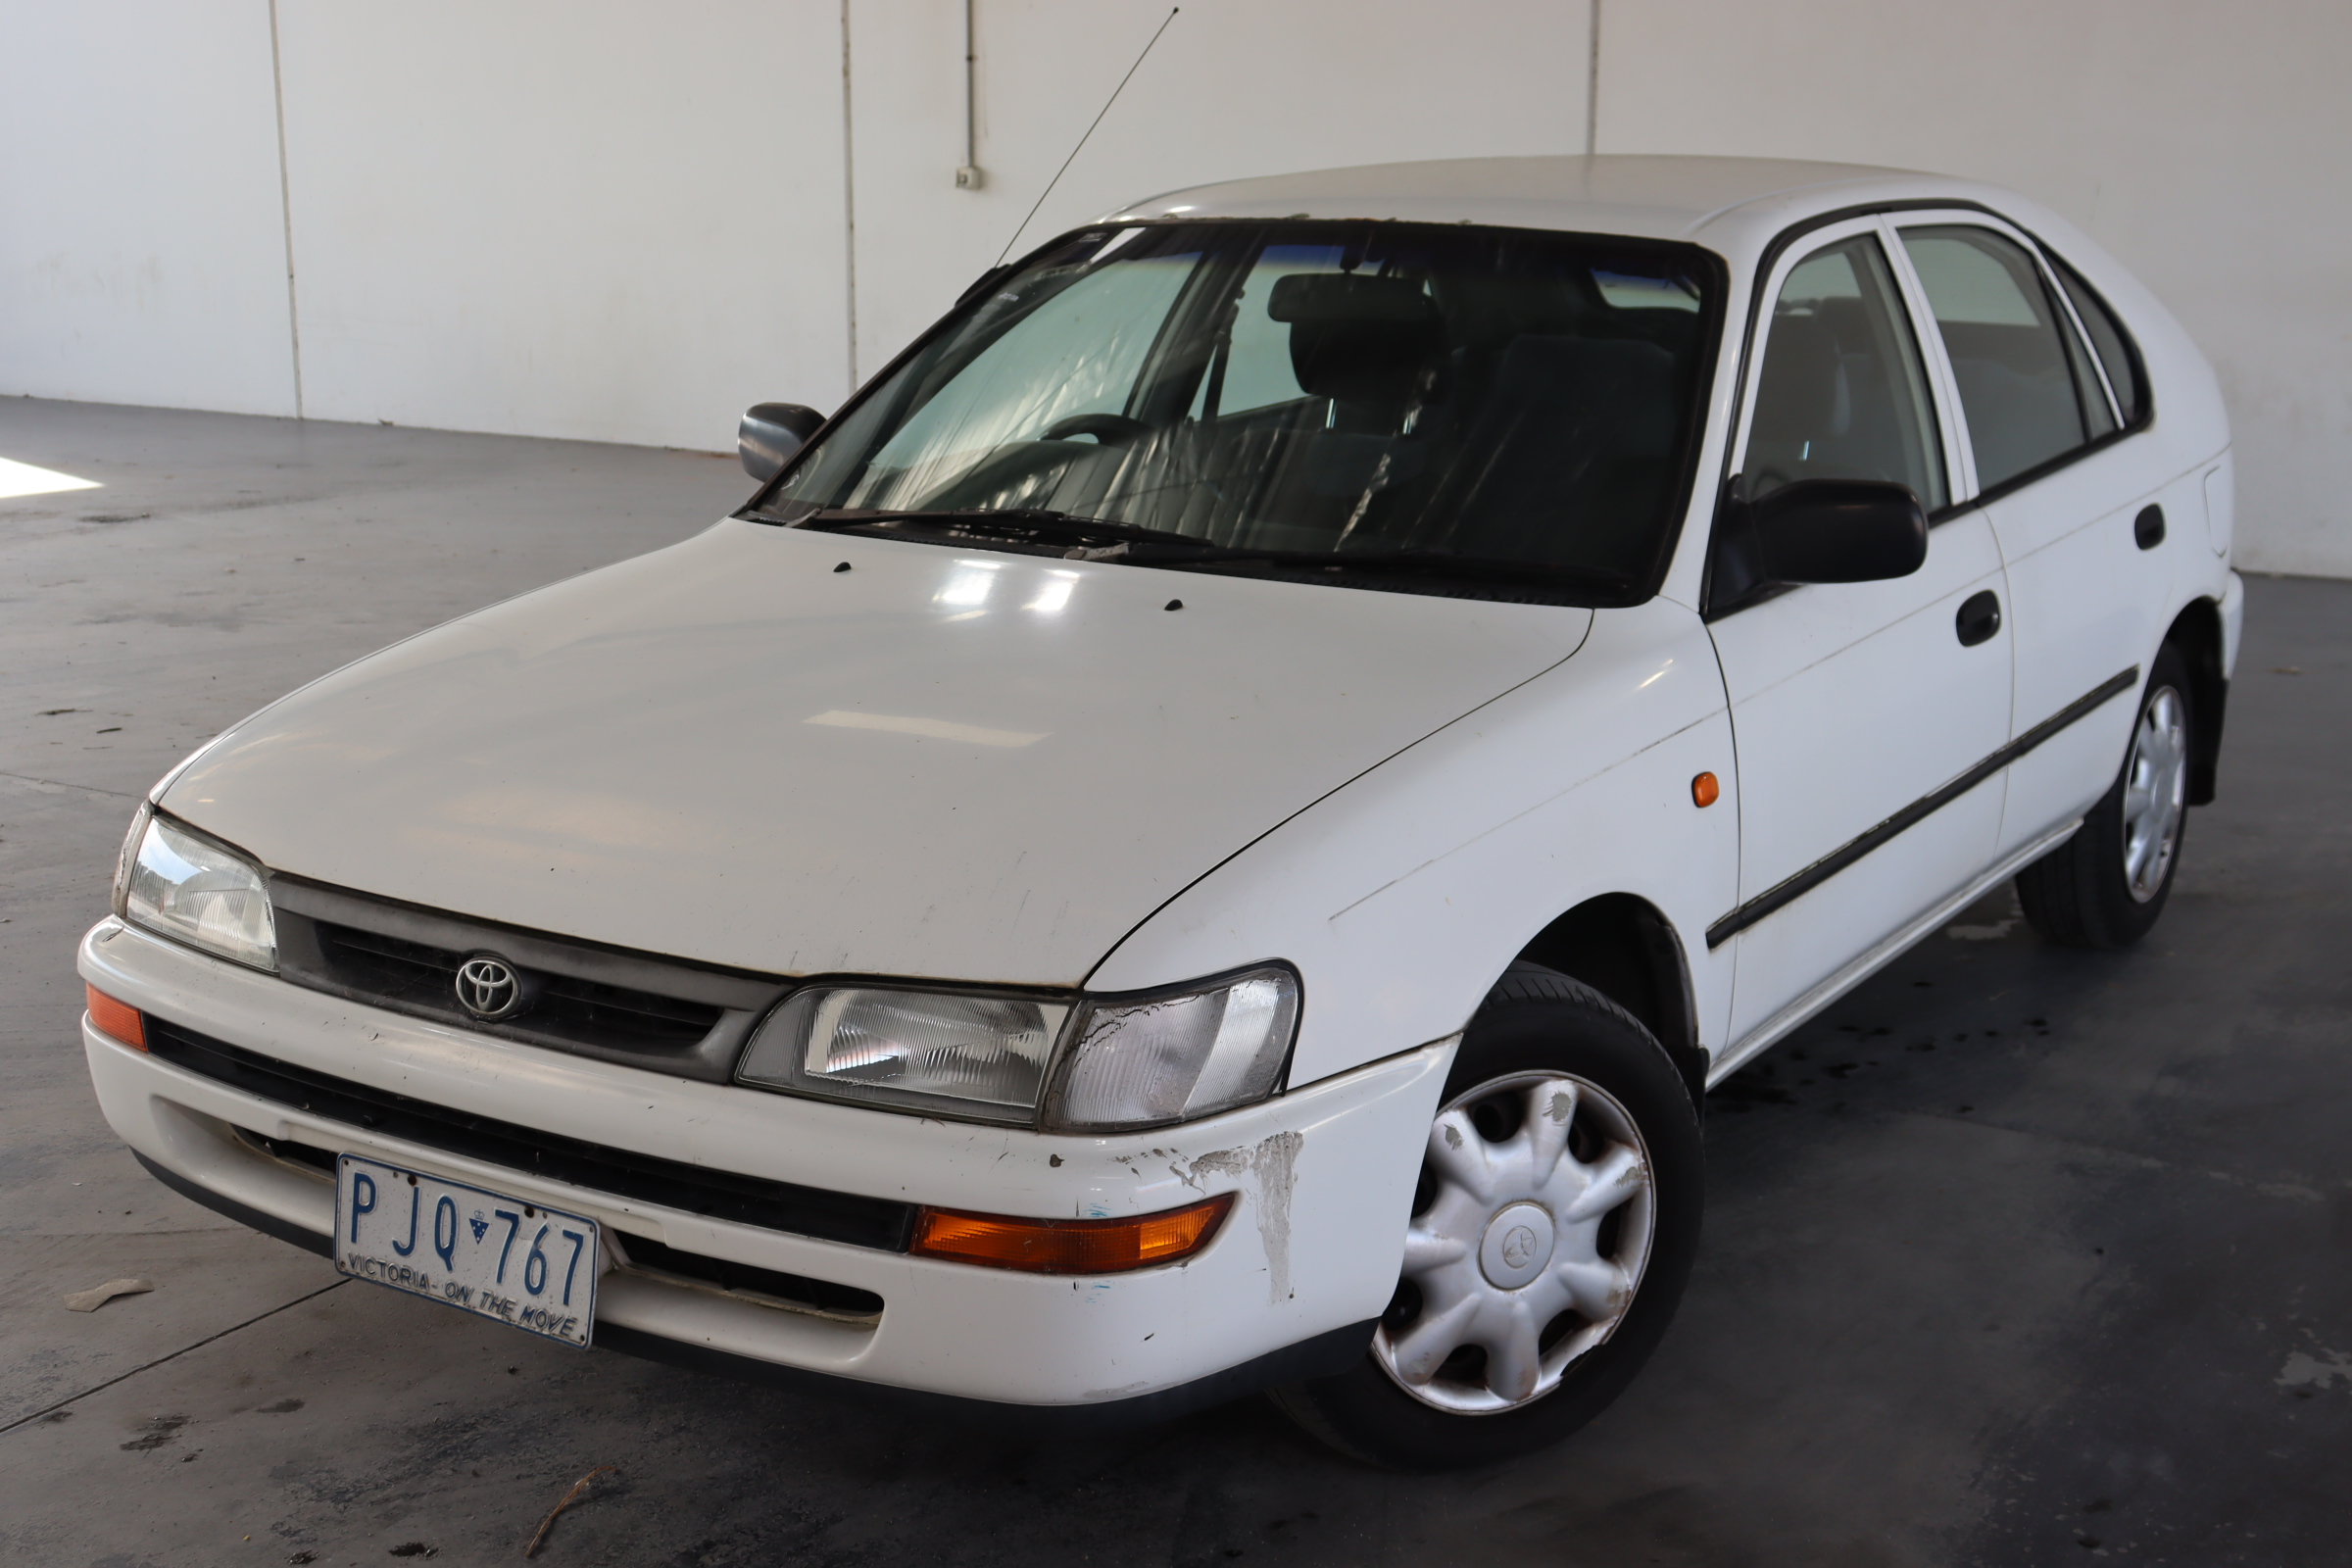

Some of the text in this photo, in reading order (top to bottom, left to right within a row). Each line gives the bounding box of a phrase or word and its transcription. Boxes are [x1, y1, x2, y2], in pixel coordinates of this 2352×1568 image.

[351, 1172, 585, 1306] PJQ 767
[444, 1280, 474, 1302] ON
[480, 1290, 516, 1316] THE
[518, 1303, 578, 1337] MOVE
